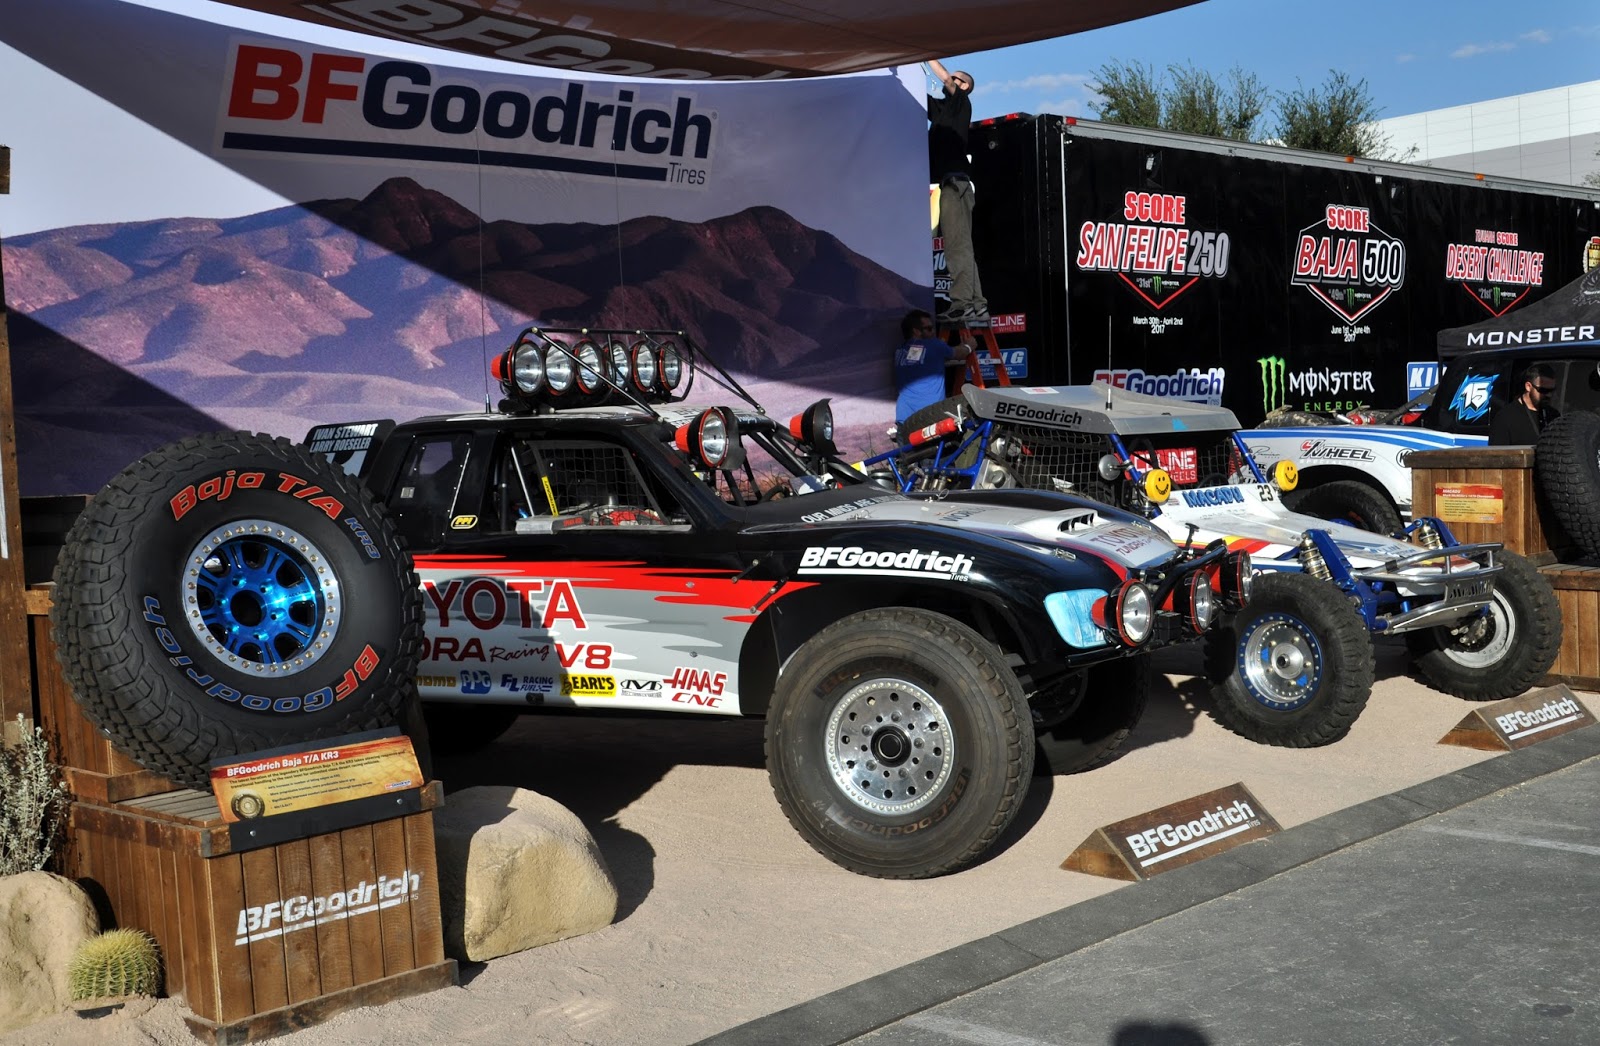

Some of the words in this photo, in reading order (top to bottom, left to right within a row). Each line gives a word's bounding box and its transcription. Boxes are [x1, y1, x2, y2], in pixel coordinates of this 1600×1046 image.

[228, 43, 712, 159] BFGoodrich
[668, 162, 706, 186] Tires
[1124, 191, 1185, 225] SCORE
[1327, 205, 1369, 232] SCORE
[1077, 221, 1125, 271] SAN
[1121, 225, 1190, 274] FELIPE
[1187, 230, 1230, 278] 250
[1496, 231, 1519, 246] SCORE
[1296, 235, 1358, 279] BAJA
[1363, 239, 1402, 284] 500
[1446, 243, 1488, 281] DESERT
[1487, 248, 1544, 285] CHALLENGE
[1133, 316, 1149, 325] March
[1151, 324, 1165, 334] 2017
[1467, 325, 1595, 346] MONSTER
[1304, 401, 1363, 412] ENERGY
[1462, 382, 1490, 409] 15
[995, 401, 1082, 425] BFGoodrich
[310, 440, 333, 452] LARRY
[334, 437, 371, 451] ROESELER
[313, 427, 336, 441] IVAN
[335, 423, 379, 439] STEWART
[1257, 484, 1274, 502] 23
[170, 470, 266, 521] Baja
[277, 473, 345, 520] T/A
[344, 517, 381, 560] KR3
[801, 512, 829, 524] OUR
[825, 503, 858, 517] MINDS
[799, 546, 973, 574] BFGoodrich
[950, 573, 969, 582] Tires
[142, 595, 380, 713] BFGoodrich
[489, 644, 550, 663] Racing
[555, 642, 613, 669] V8
[523, 676, 554, 685] RACING
[572, 676, 615, 690] EARL'S
[663, 667, 728, 696] HAAS
[671, 692, 723, 708] CNC
[1495, 696, 1580, 734] BFGoodrich
[227, 761, 280, 777] BFGoodrich
[282, 757, 302, 768] Baja
[303, 753, 319, 764] T/A
[321, 751, 339, 761] KR3
[1126, 799, 1256, 859] BFGoodrich
[236, 869, 420, 936] BFGoodrich
